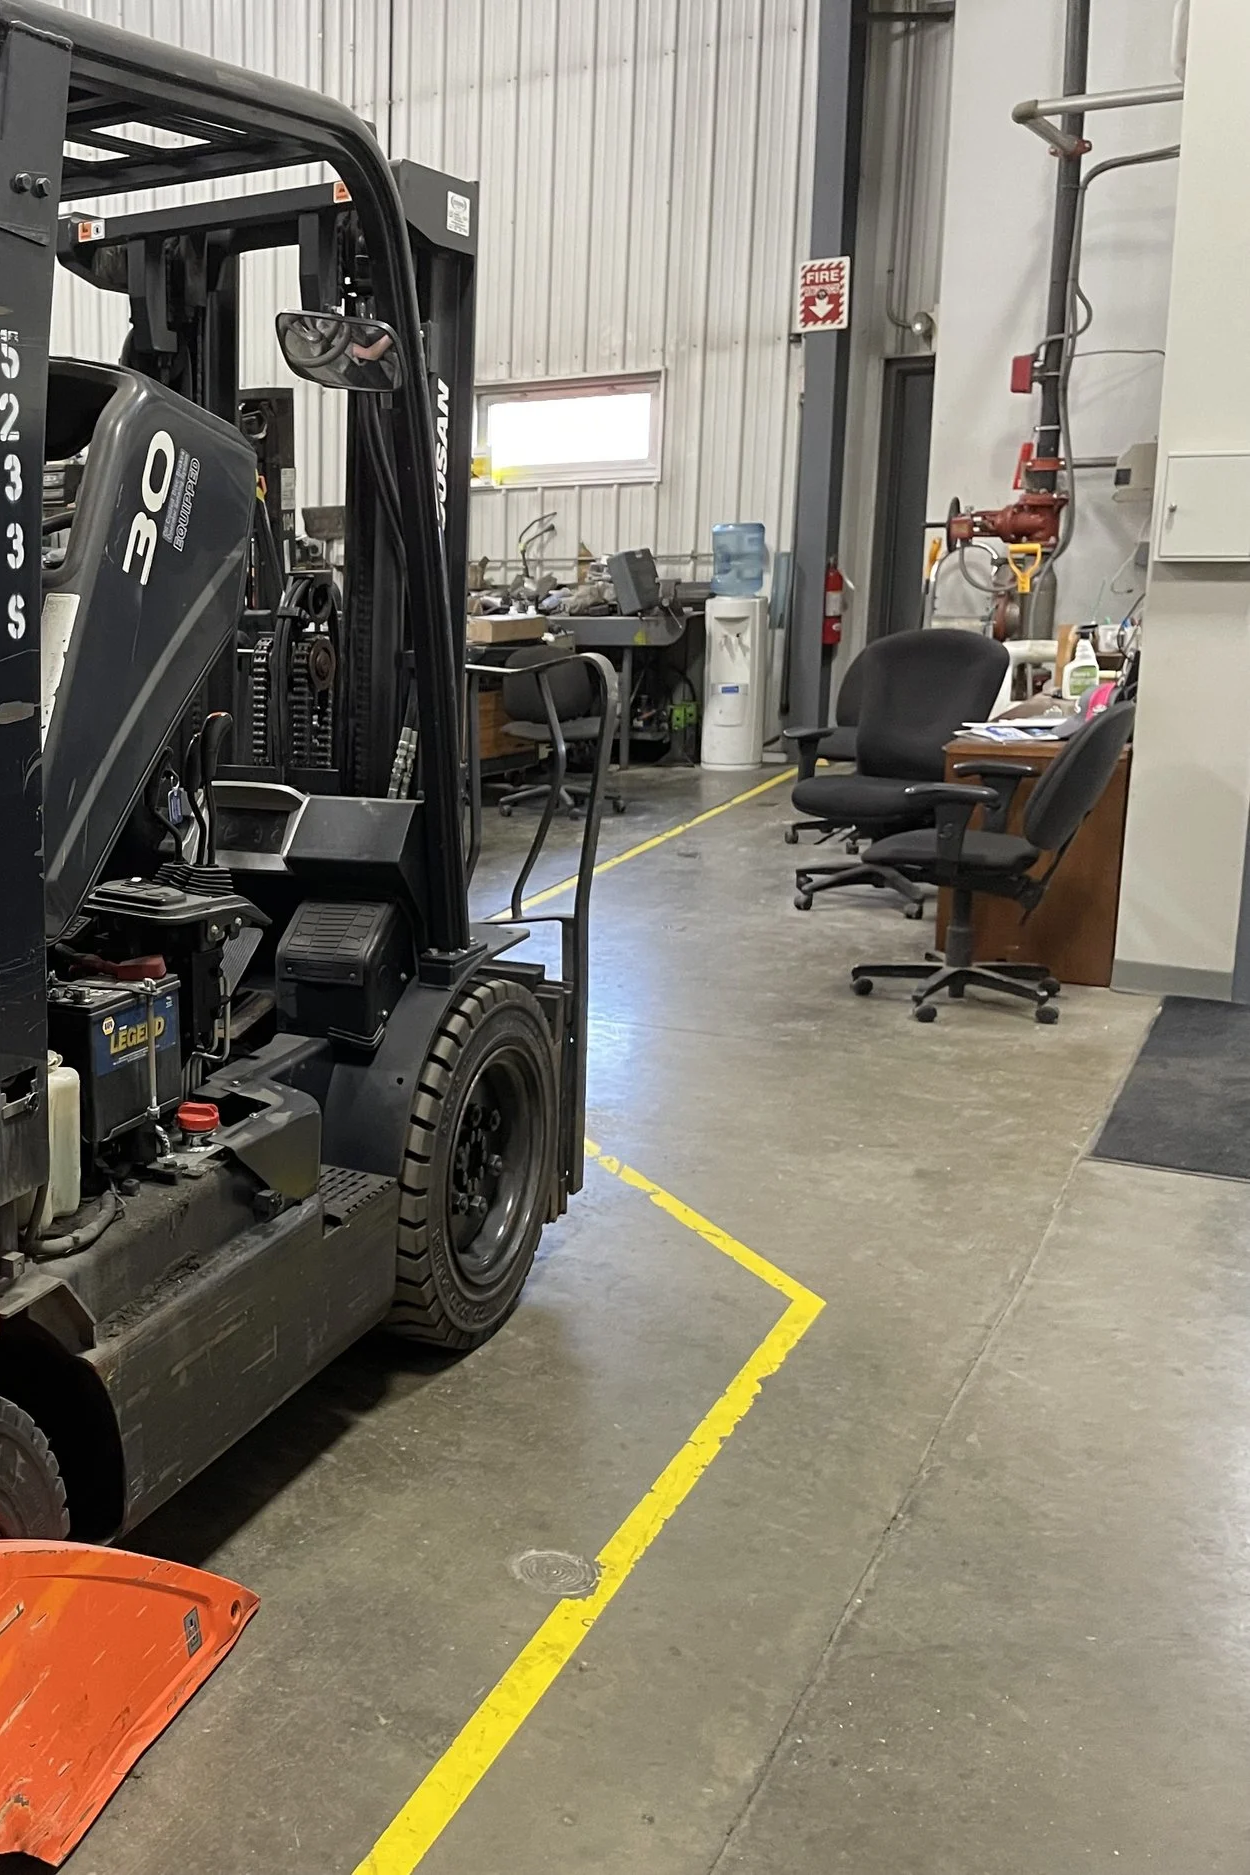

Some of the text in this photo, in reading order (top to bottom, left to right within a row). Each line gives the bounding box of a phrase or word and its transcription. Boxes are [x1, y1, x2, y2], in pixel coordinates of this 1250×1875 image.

[806, 269, 840, 285] FIRE
[122, 430, 175, 586] 30
[173, 457, 200, 552] EQUIPPED
[435, 377, 450, 532] OSAN
